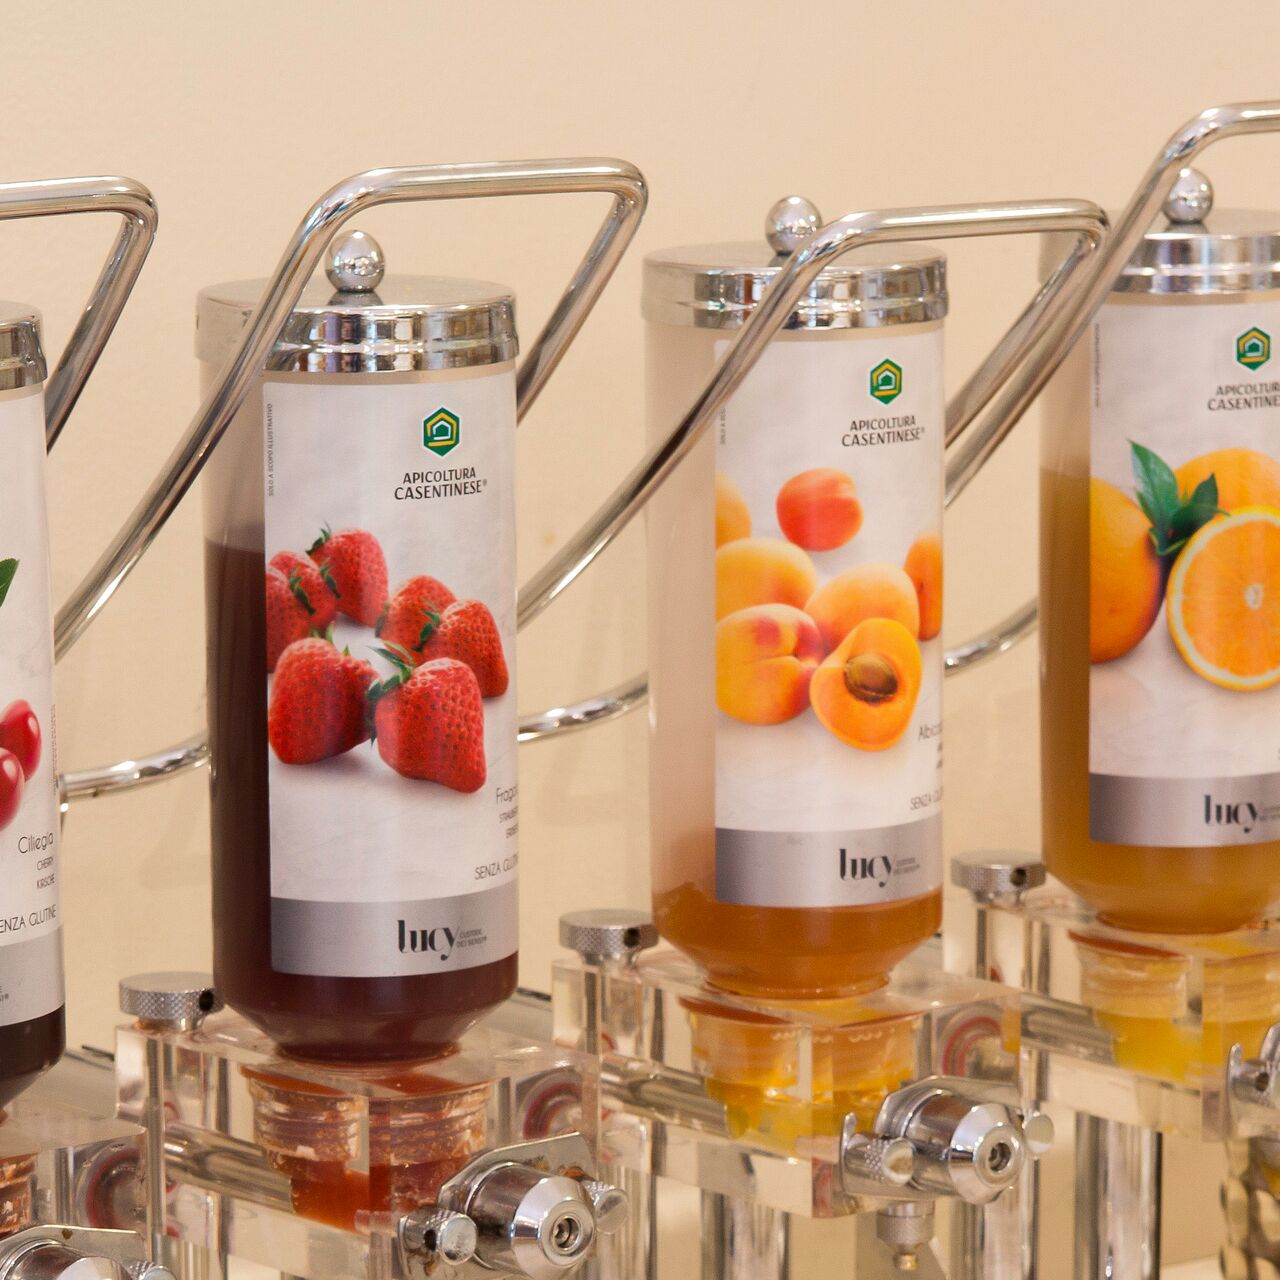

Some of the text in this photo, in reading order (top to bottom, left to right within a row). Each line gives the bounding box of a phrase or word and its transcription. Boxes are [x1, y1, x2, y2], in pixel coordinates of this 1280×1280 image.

[850, 415, 917, 431] APICOLTURA
[402, 467, 476, 484] APICOLTURA
[1204, 795, 1261, 833] lucy
[839, 848, 895, 888] lucy
[29, 904, 56, 926] GLUTINE
[397, 919, 460, 961] lucy
